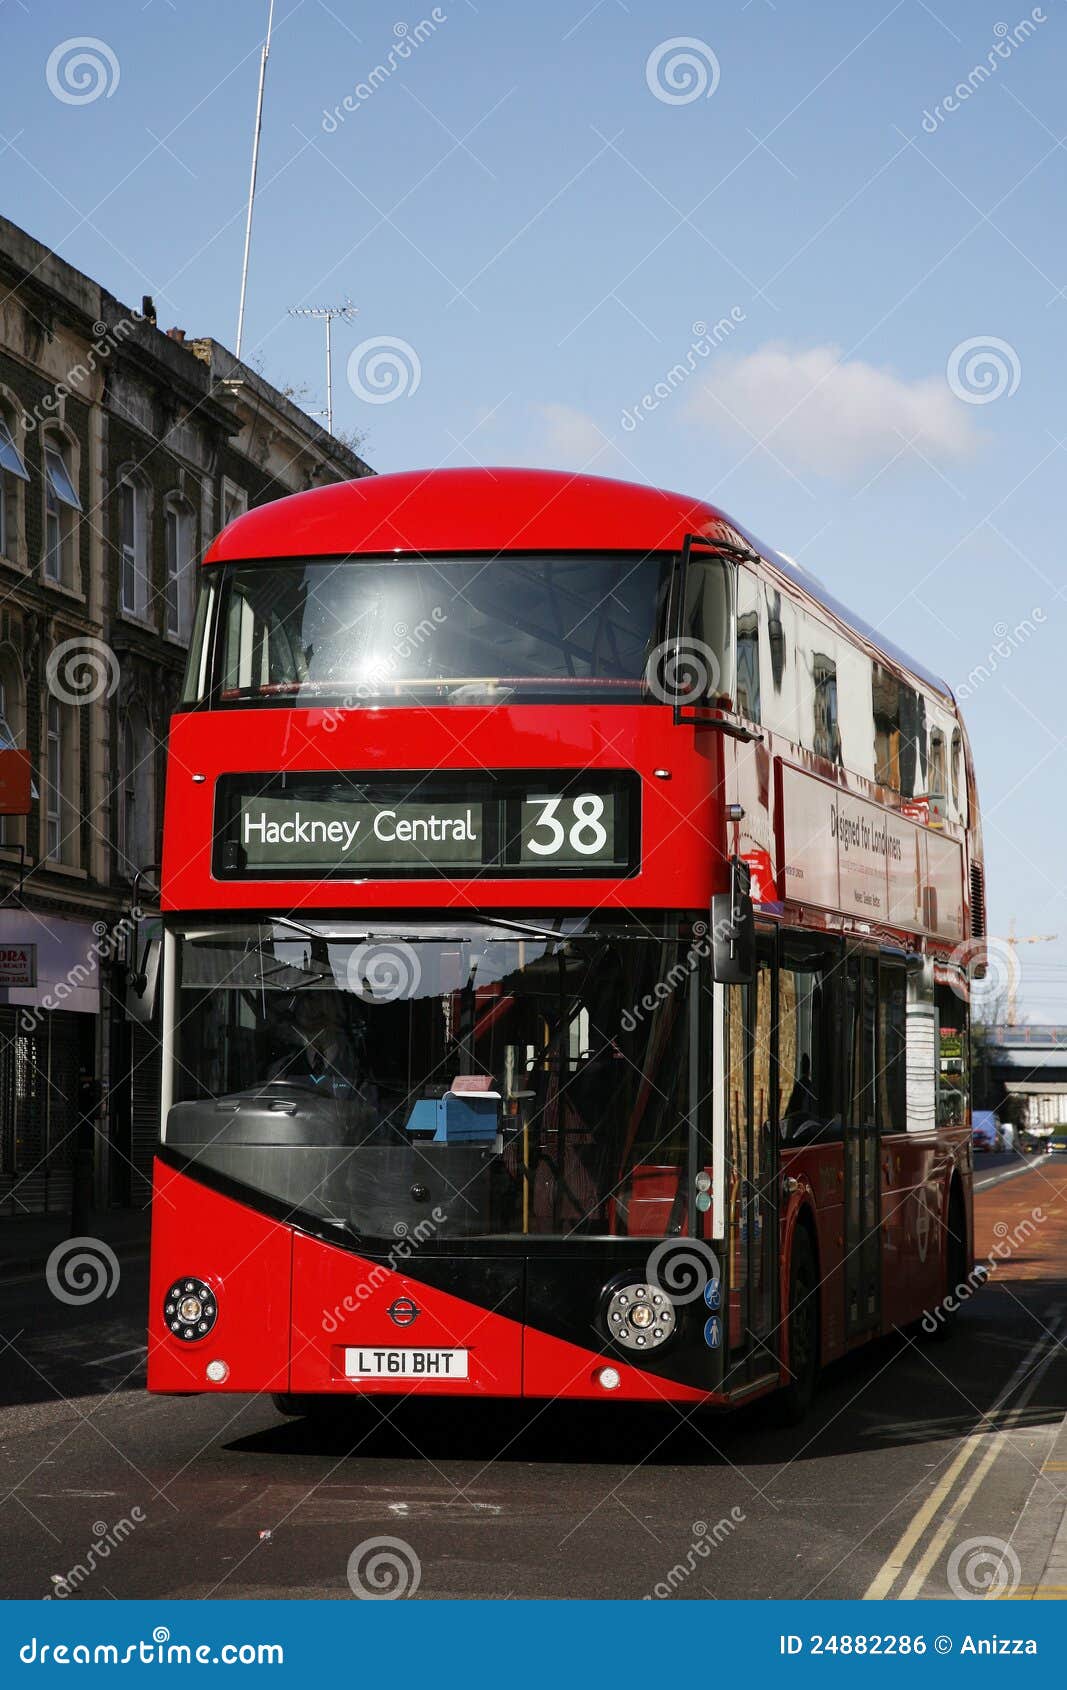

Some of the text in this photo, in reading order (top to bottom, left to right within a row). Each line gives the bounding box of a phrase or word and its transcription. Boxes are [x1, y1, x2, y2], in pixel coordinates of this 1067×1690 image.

[244, 794, 607, 855] Hackney Central 38
[359, 1352, 453, 1373] LT61 BHT
